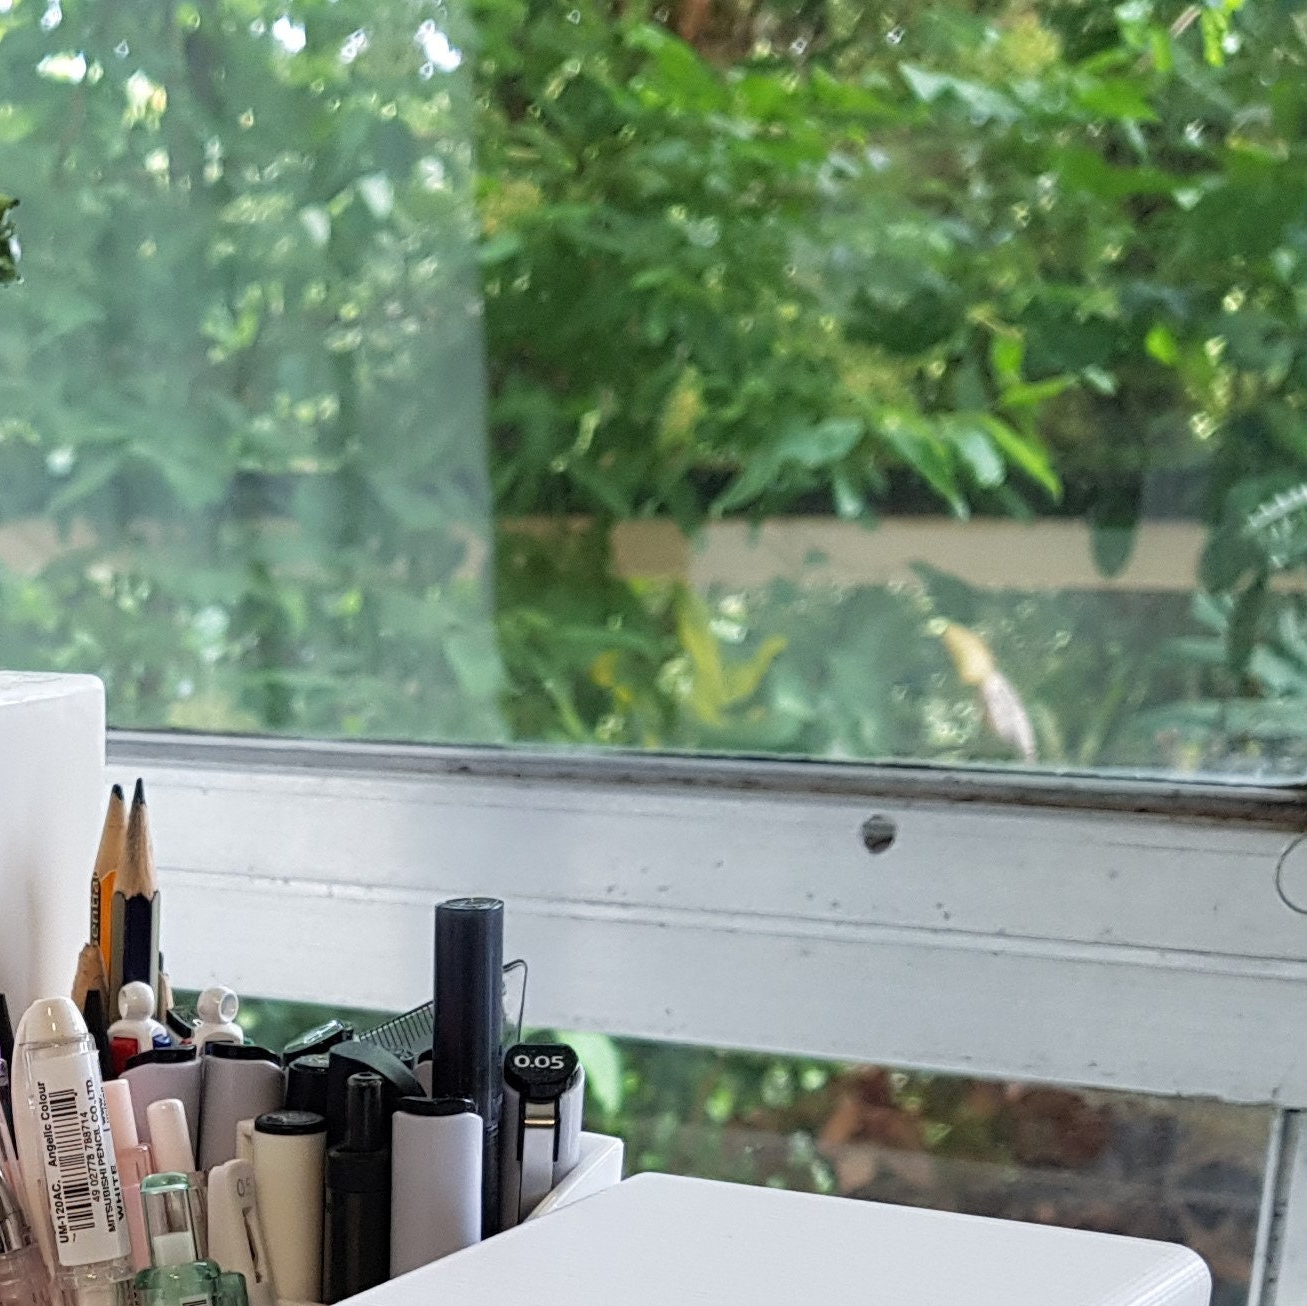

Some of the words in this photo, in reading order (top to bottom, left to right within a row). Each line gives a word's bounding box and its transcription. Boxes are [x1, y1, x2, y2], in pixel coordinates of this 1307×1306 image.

[513, 1054, 565, 1071] 0.05
[37, 1081, 51, 1121] Colour
[43, 1124, 58, 1168] Angelic
[93, 1124, 106, 1166] PENCIL
[100, 1167, 117, 1233] MITSUBISHI
